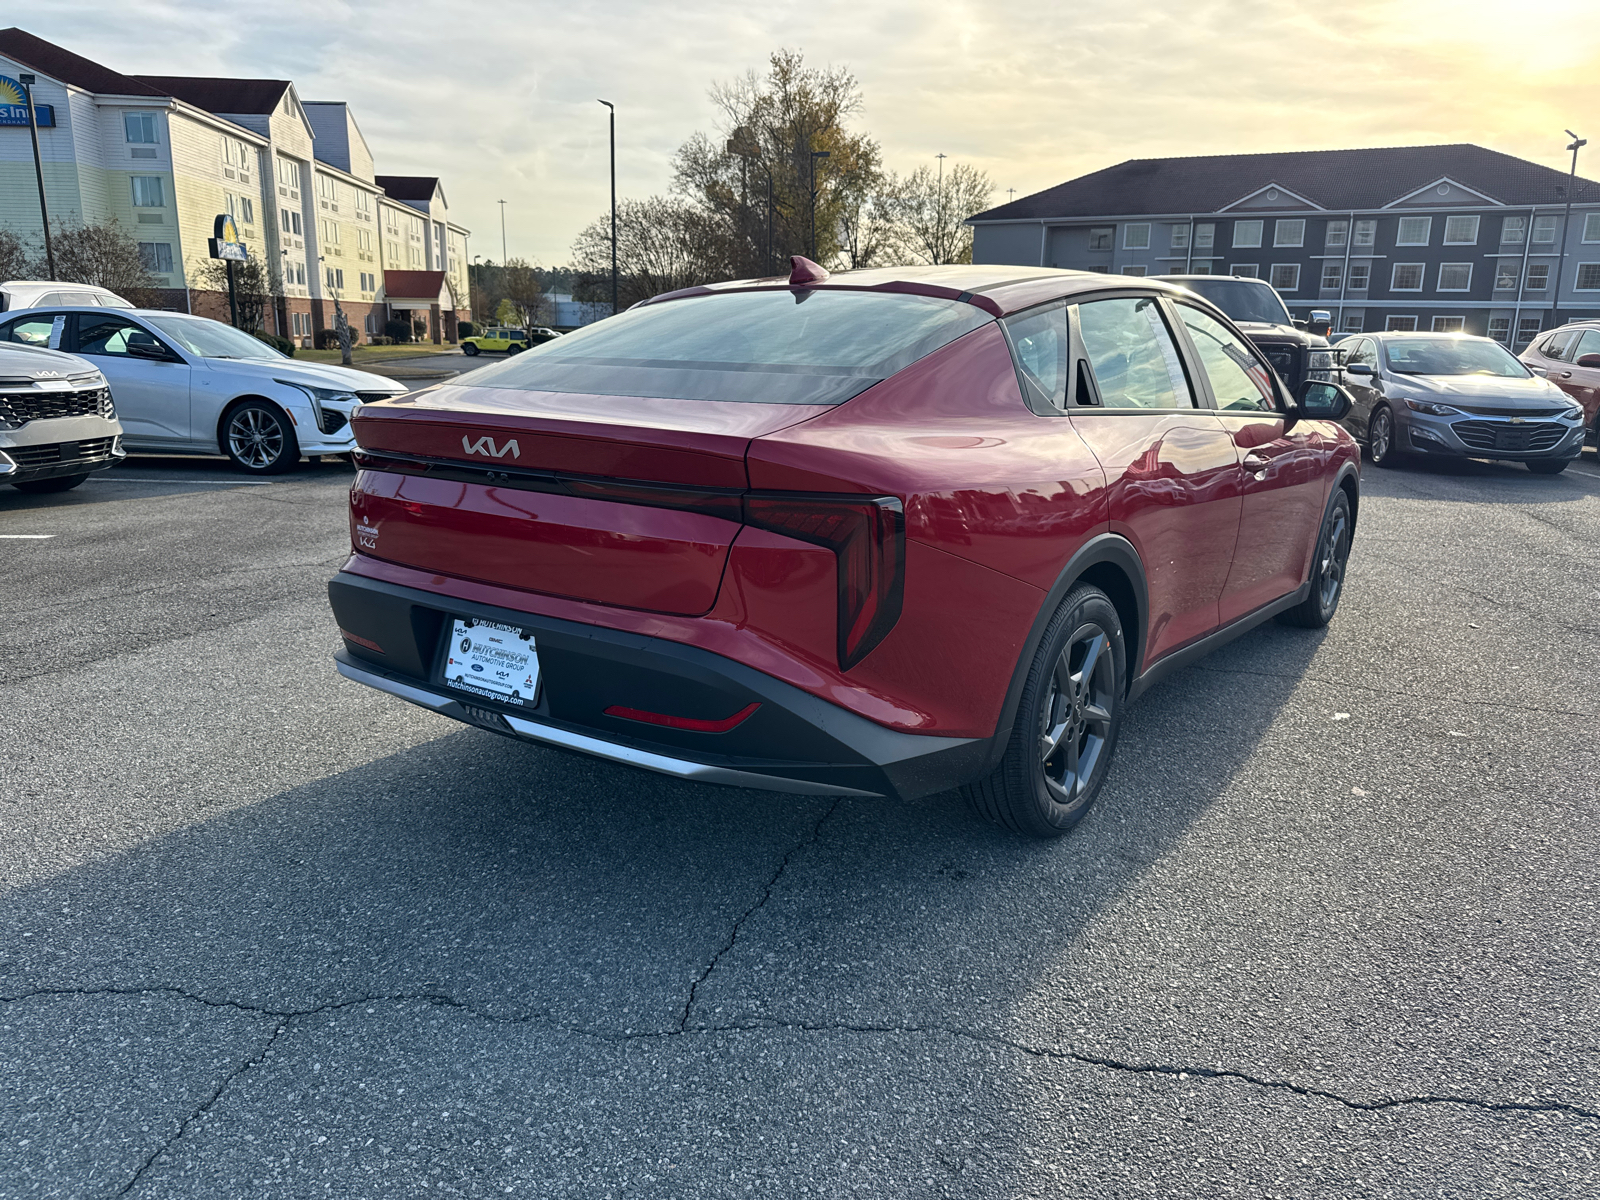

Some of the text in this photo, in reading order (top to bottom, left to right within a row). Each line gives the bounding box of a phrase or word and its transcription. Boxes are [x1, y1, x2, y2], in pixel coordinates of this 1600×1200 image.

[461, 434, 521, 459] KIA
[360, 536, 376, 549] K4
[480, 619, 523, 635] HUTCHINSON
[471, 653, 525, 672] AUTOMOTIVE GROUP
[447, 679, 524, 706] Hutchinsonautogroup.com
